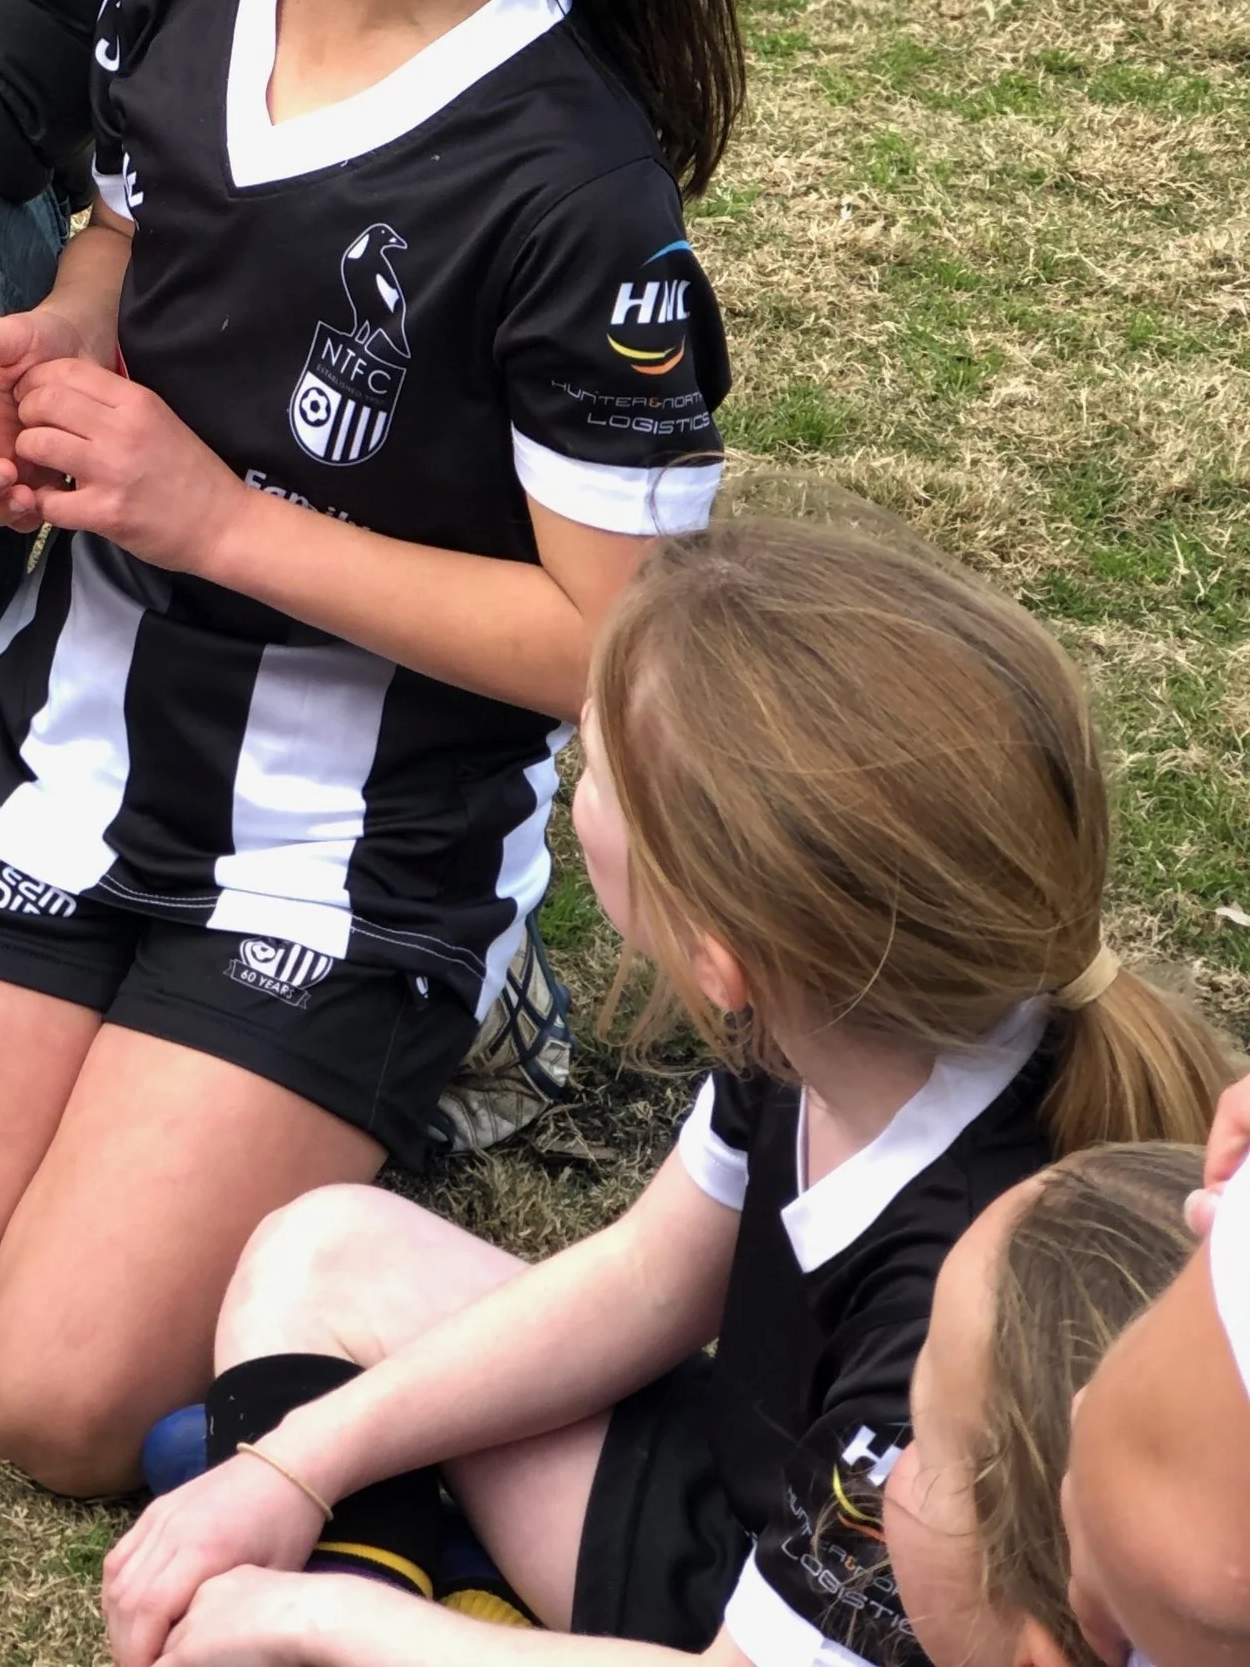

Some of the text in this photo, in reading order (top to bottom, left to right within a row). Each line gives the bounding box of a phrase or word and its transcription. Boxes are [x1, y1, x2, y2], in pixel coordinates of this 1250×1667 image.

[321, 337, 392, 395] NTFC
[587, 412, 711, 435] LOGISTICS
[240, 969, 295, 999] 60 YEARS
